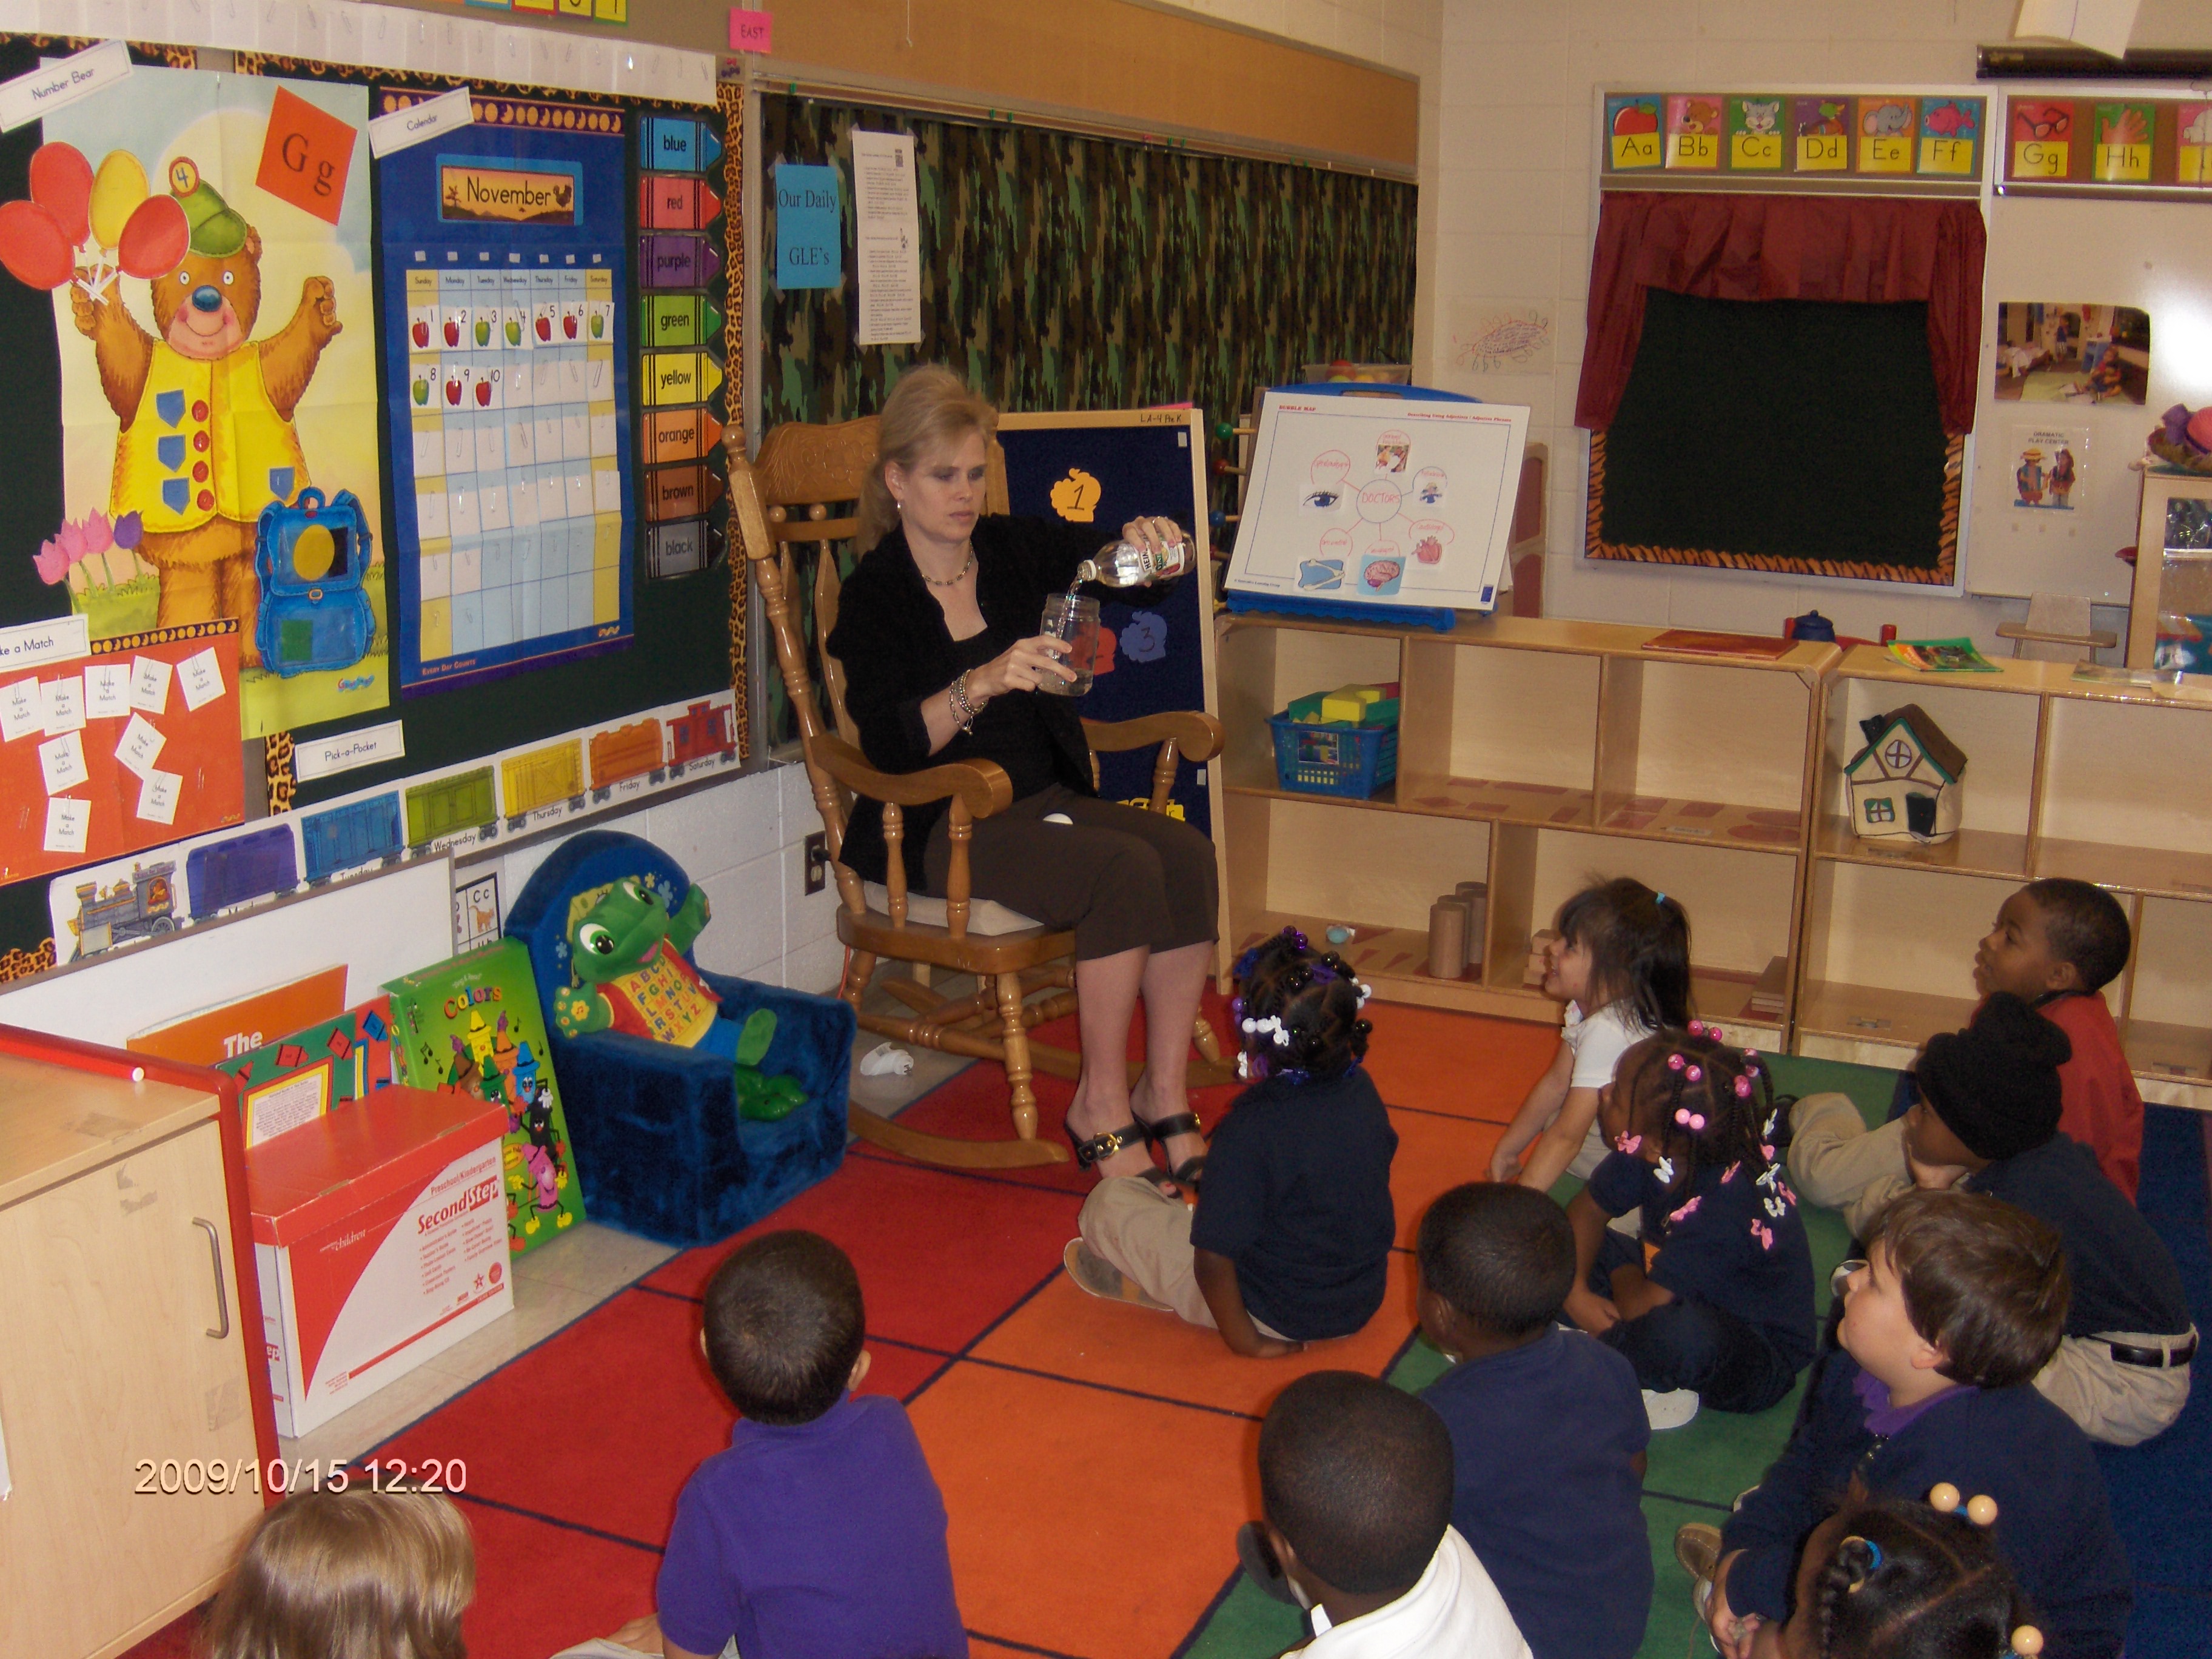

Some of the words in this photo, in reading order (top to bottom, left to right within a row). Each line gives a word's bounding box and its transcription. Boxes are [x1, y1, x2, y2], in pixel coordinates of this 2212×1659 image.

[740, 25, 765, 39] EAST
[32, 79, 70, 100] Number
[72, 66, 96, 85] Bear
[407, 112, 438, 131] Calendar
[663, 134, 687, 152] blue
[175, 167, 189, 188] 4
[466, 176, 552, 206] November
[666, 195, 683, 210] red
[778, 190, 802, 208] Our
[805, 189, 837, 213] Daily
[657, 252, 691, 271] purple
[789, 247, 830, 266] GLE's
[415, 276, 432, 286] Sunday
[446, 276, 465, 286] Monday
[535, 275, 553, 285] Thursday
[565, 275, 577, 284] Friday
[590, 275, 608, 285] Saturday
[431, 309, 434, 322] 1
[461, 310, 466, 323] 2
[491, 310, 497, 323] 3
[520, 310, 526, 324] 4
[550, 305, 555, 318] 5
[578, 304, 583, 317] 6
[606, 305, 610, 316] 7
[660, 313, 690, 330] green
[431, 367, 437, 381] 8
[464, 369, 470, 382] 9
[491, 369, 500, 382] 10
[660, 369, 691, 389] yellow
[659, 428, 694, 444] orange
[662, 485, 694, 500] brown
[1067, 484, 1085, 511] 1
[1362, 492, 1400, 503] DOCTORS
[665, 540, 693, 556] black
[24, 635, 54, 651] Match
[1139, 626, 1155, 652] 3
[141, 687, 155, 696] Match
[196, 680, 210, 691] Match
[14, 711, 30, 720] Match
[131, 745, 144, 759] Match
[325, 741, 377, 762] Pick-a-Pocket
[56, 765, 73, 774] Match
[689, 759, 715, 771] Saturday
[619, 780, 640, 792] Friday
[151, 798, 165, 806] Match
[533, 805, 563, 820] Thursday
[434, 833, 476, 851] Wednesday
[631, 980, 641, 992] A
[640, 970, 651, 983] B
[637, 991, 646, 1005] F
[649, 983, 660, 996] G
[658, 974, 668, 987] H
[444, 985, 502, 1019] Colors
[646, 1007, 657, 1017] L
[665, 986, 675, 1000] N
[674, 979, 682, 991] O
[654, 1016, 666, 1030] R
[665, 1008, 675, 1020] S
[673, 999, 682, 1010] T
[662, 1028, 675, 1042] W
[674, 1021, 683, 1033] X
[682, 1011, 691, 1023] Y
[690, 1004, 701, 1016] Z
[224, 1031, 263, 1058] The
